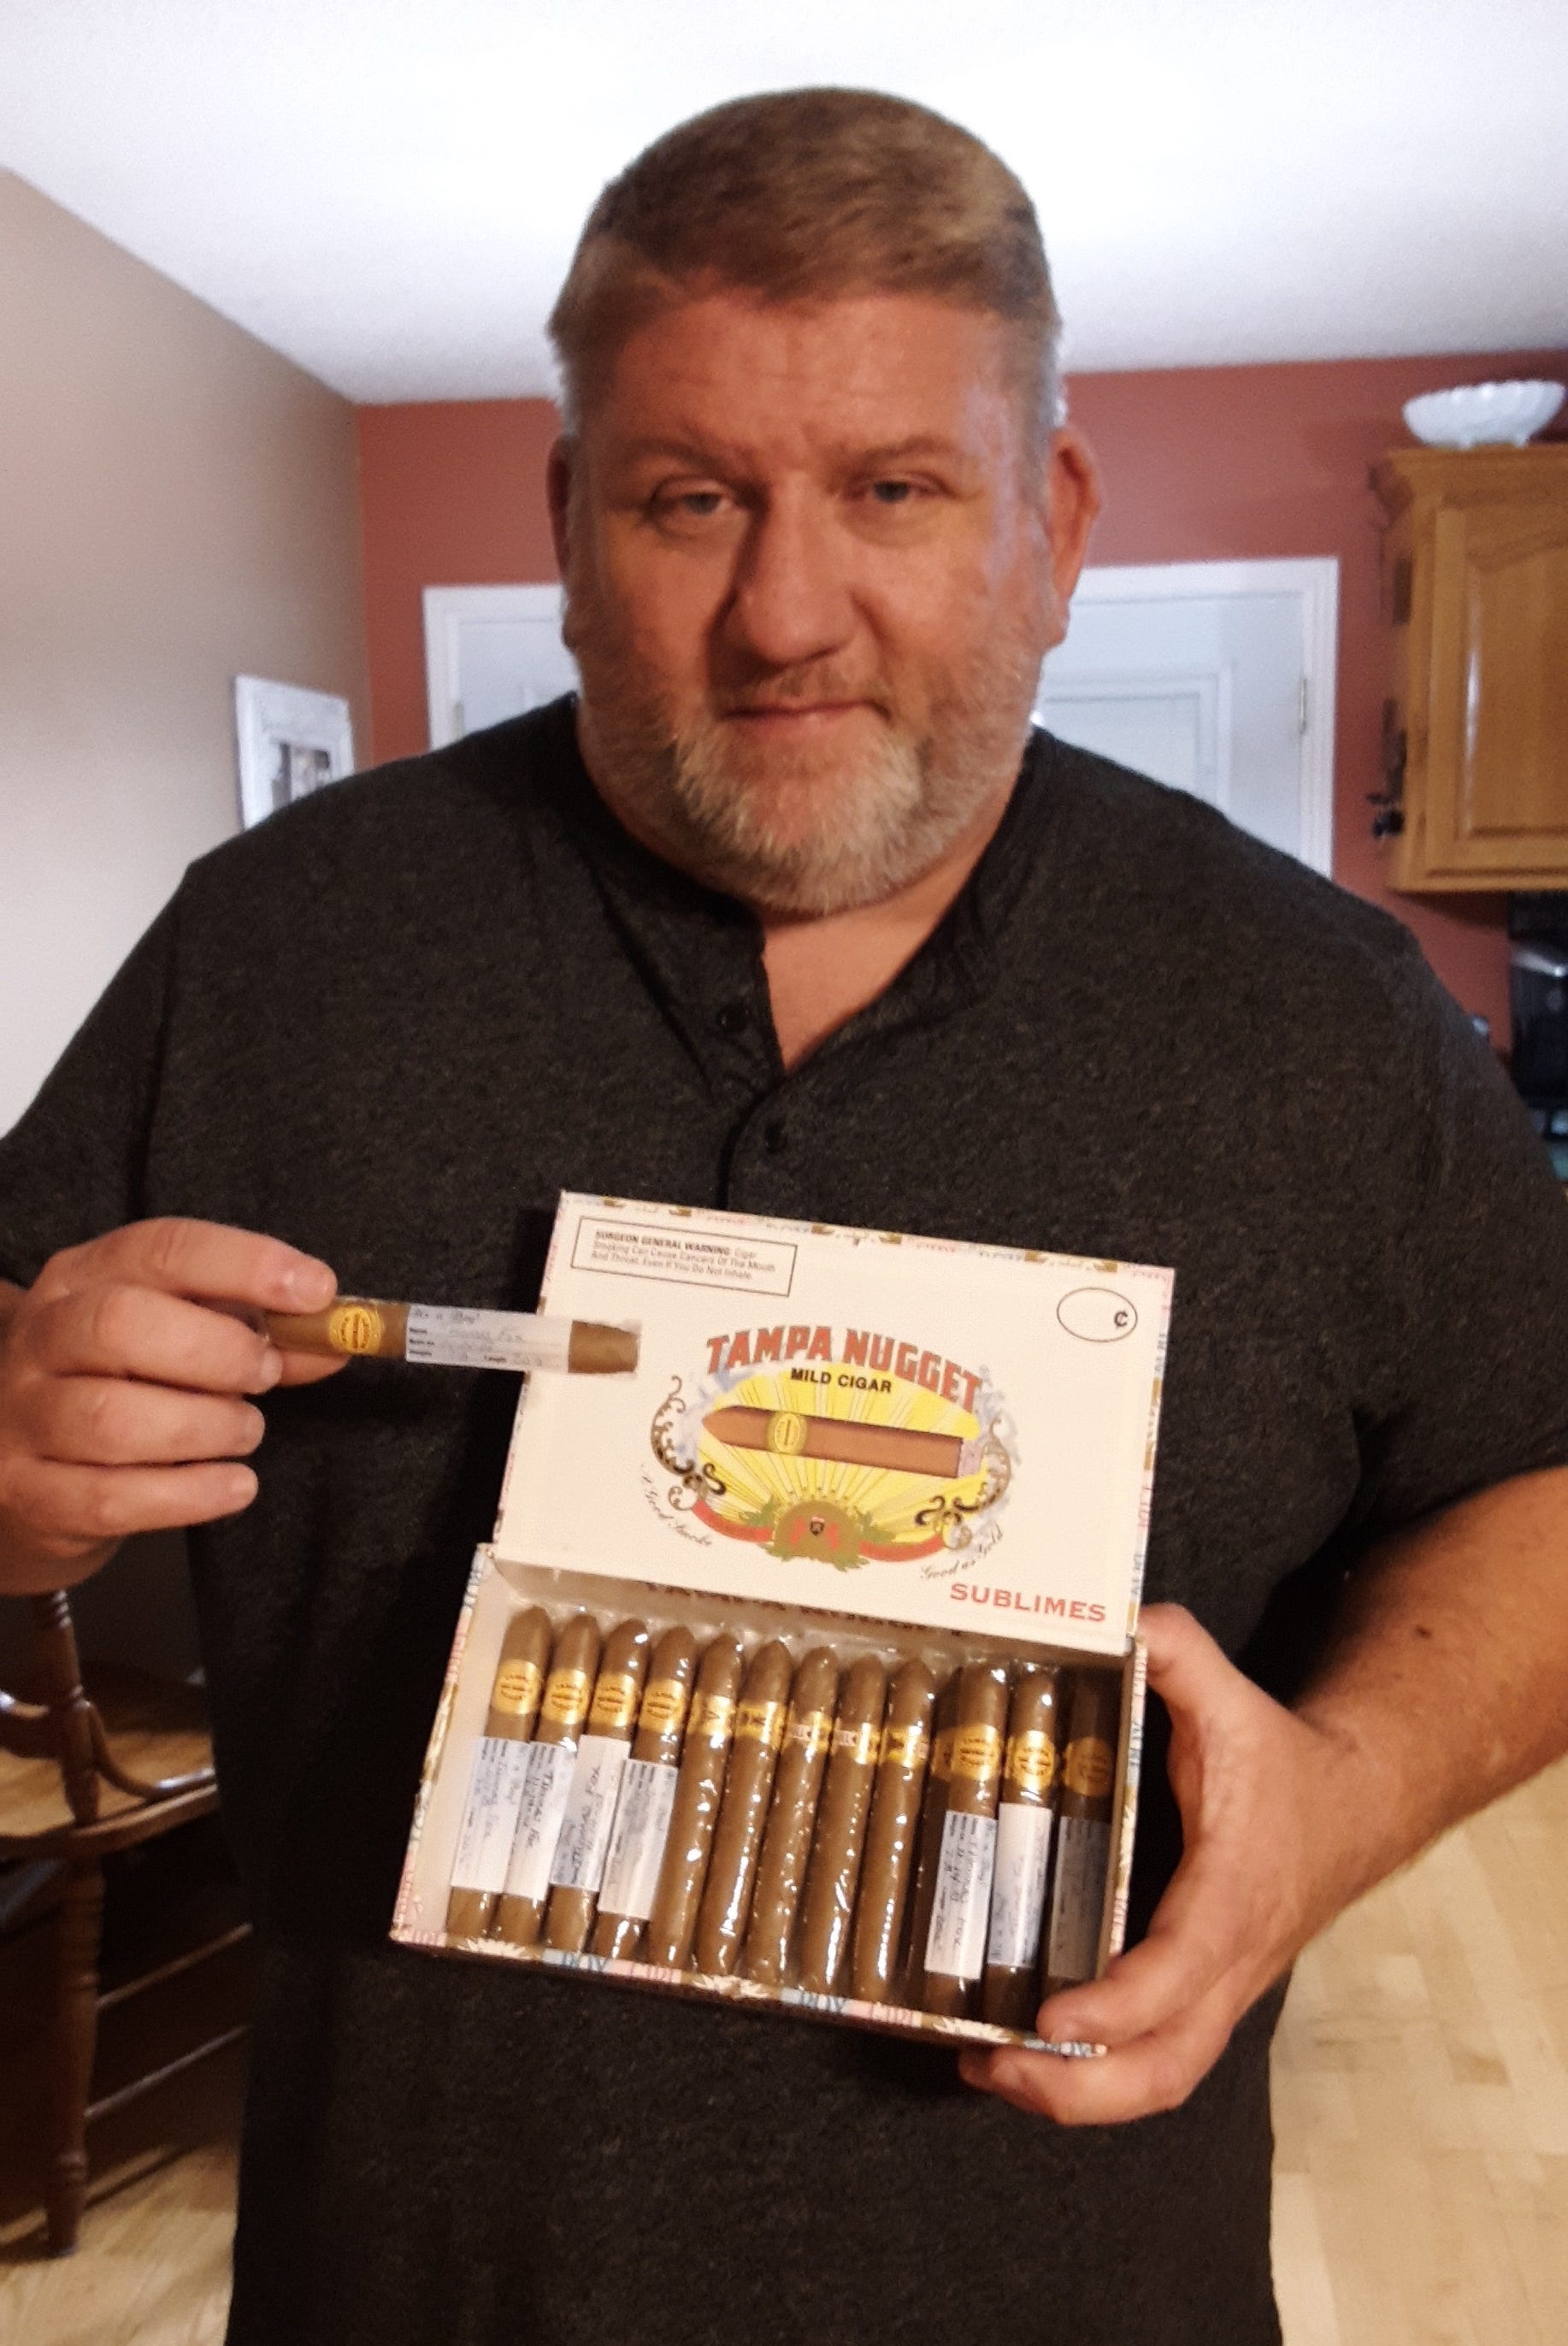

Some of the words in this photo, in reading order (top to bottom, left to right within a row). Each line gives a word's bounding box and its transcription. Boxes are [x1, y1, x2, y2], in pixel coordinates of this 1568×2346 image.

[596, 1230, 639, 1244] SURGEON
[641, 1235, 681, 1250] GENERAL
[730, 1258, 746, 1268] The
[748, 1261, 776, 1273] Mouth
[706, 1325, 833, 1375] TAMPA
[842, 1327, 982, 1414] NUGGET
[791, 1367, 832, 1385] MILD
[837, 1374, 893, 1394] CIGAR
[950, 1583, 1106, 1623] SUBLIMES
